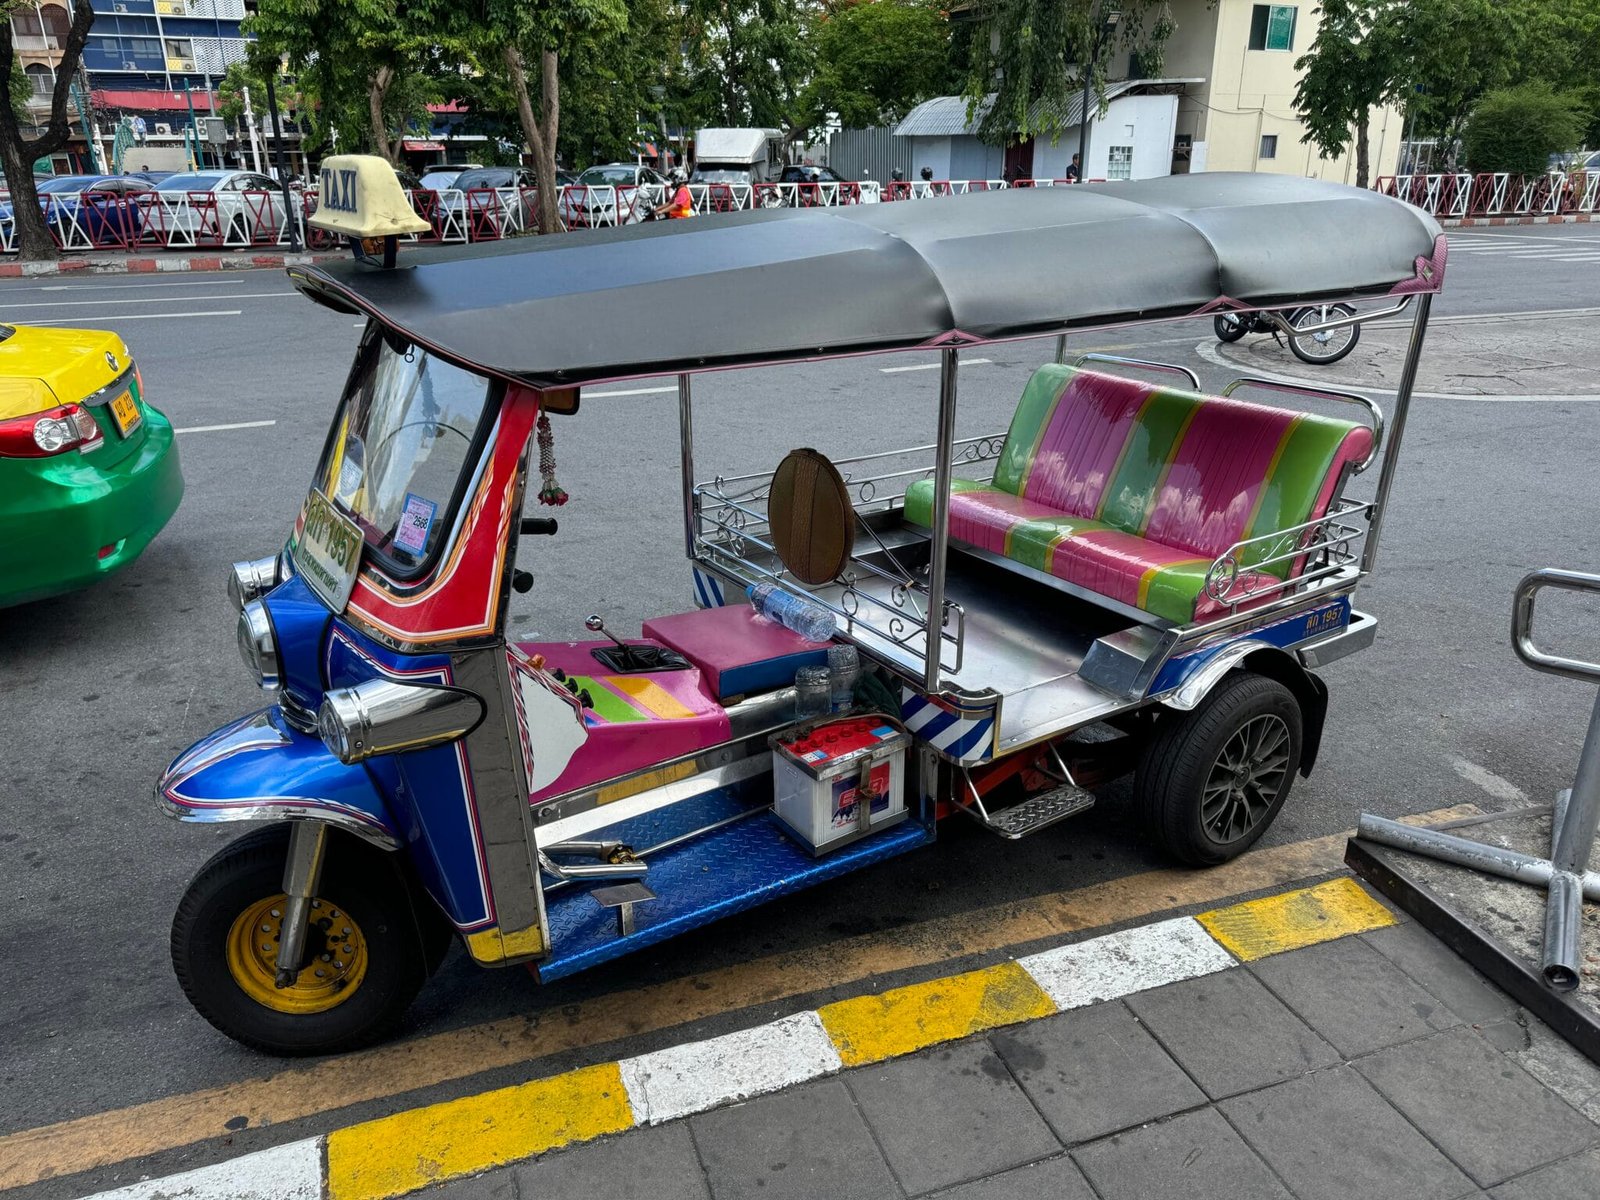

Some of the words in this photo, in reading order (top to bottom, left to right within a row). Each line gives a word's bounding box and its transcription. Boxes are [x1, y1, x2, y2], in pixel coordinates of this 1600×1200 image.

[322, 168, 357, 212] TAXI
[325, 517, 359, 573] 1957
[1322, 606, 1344, 624] 1957
